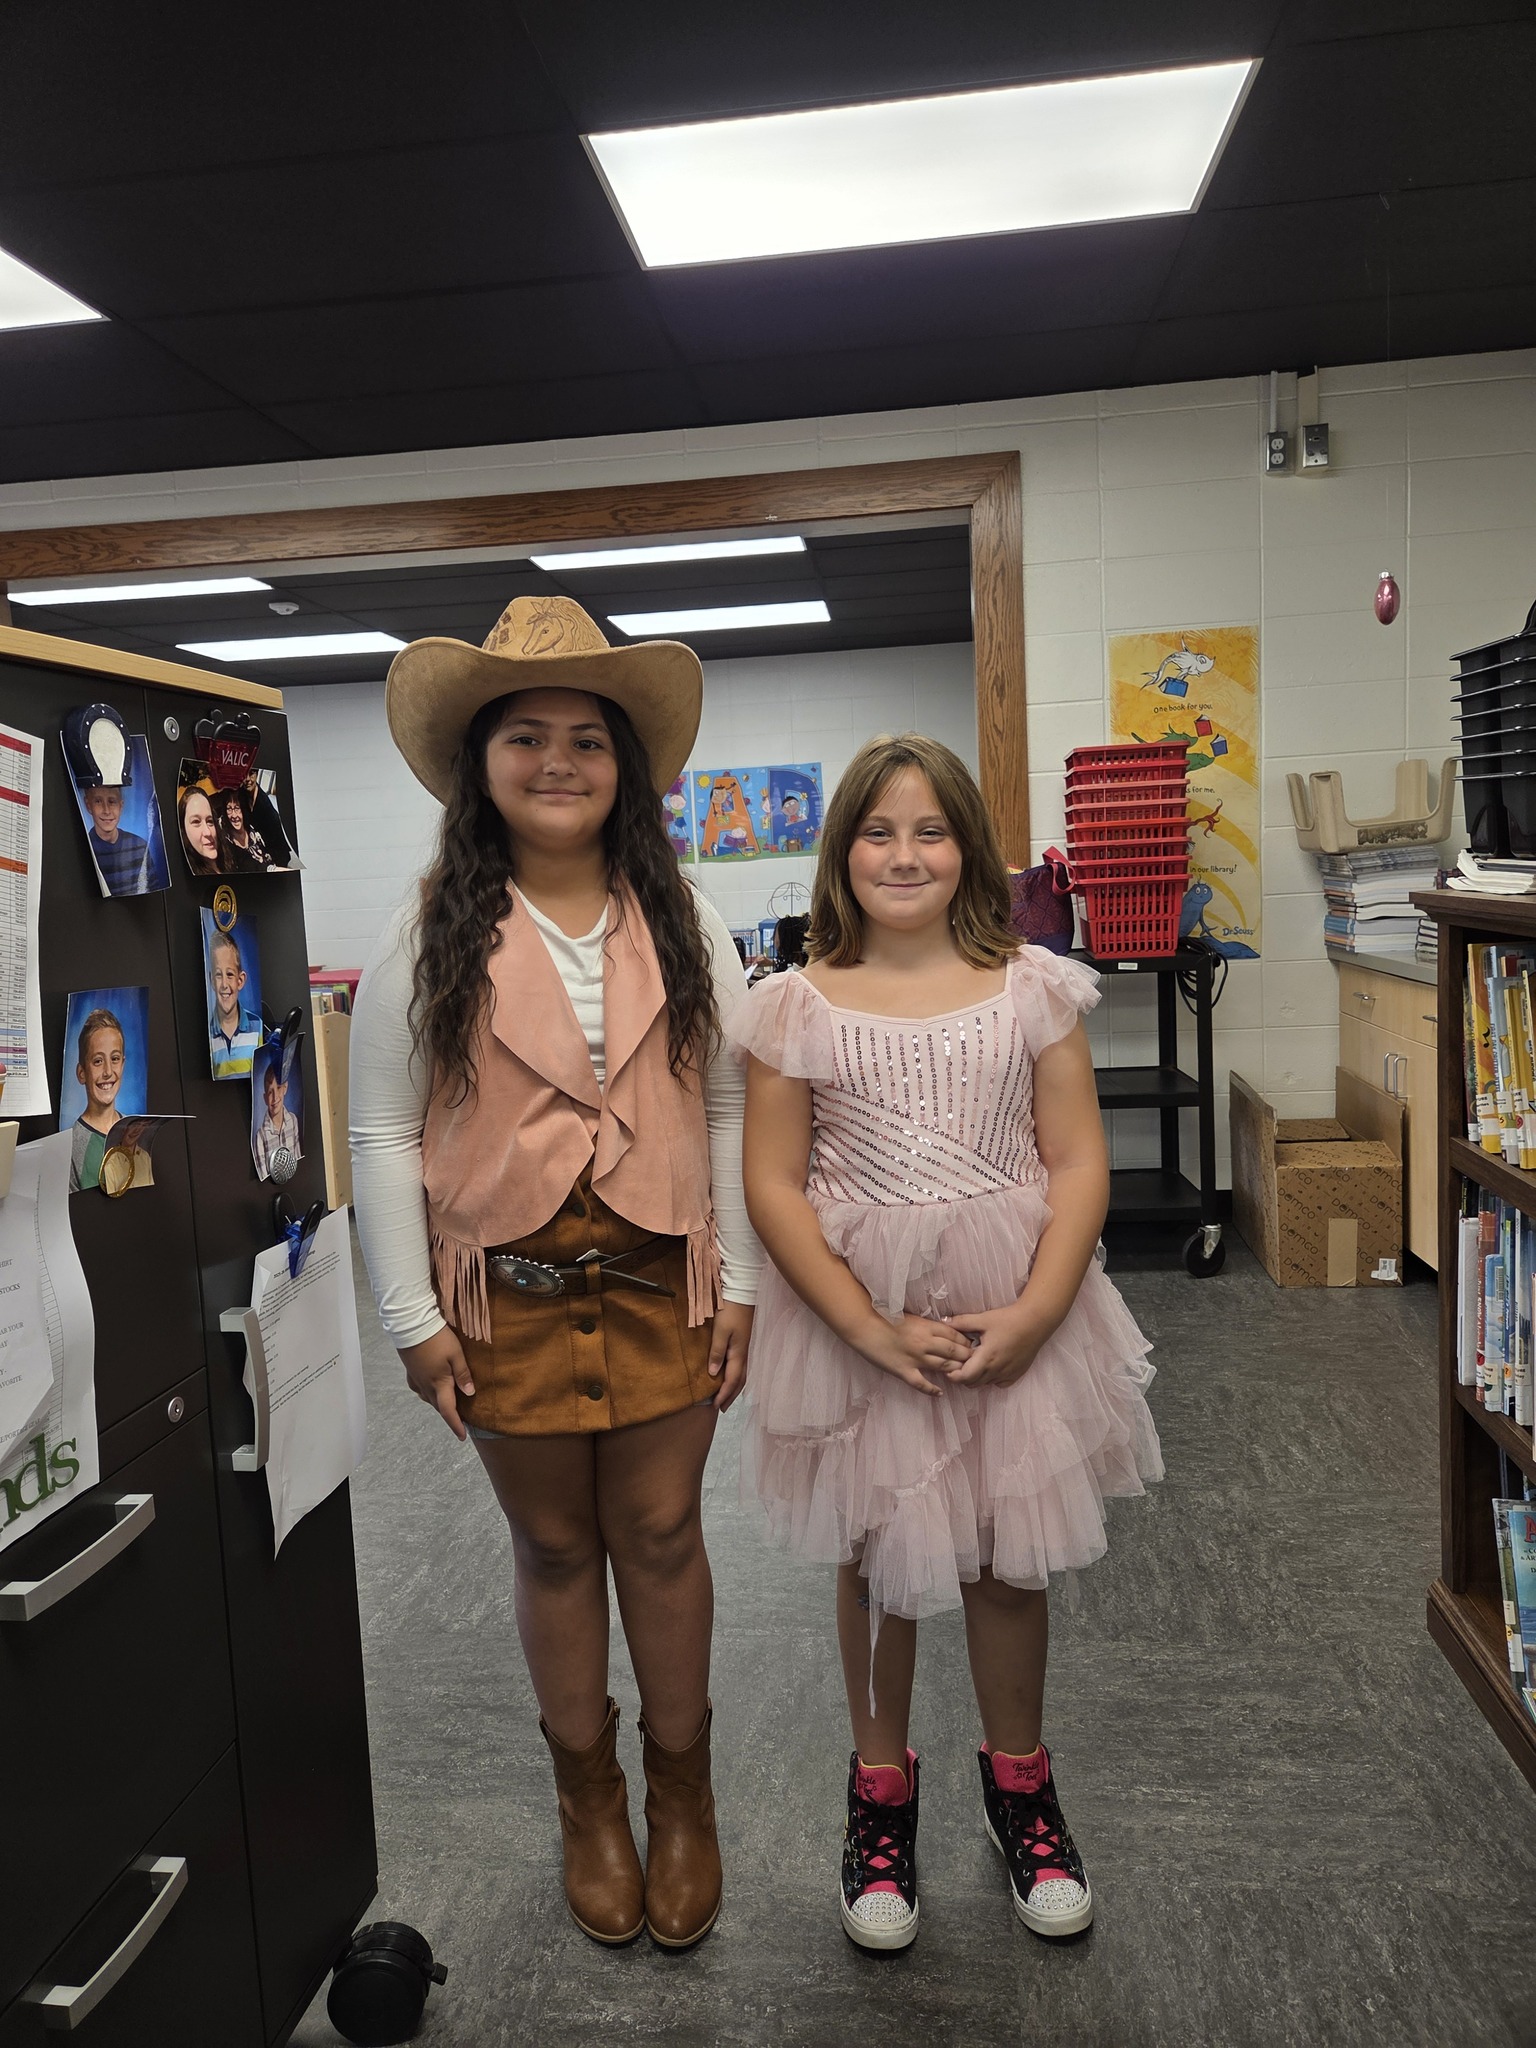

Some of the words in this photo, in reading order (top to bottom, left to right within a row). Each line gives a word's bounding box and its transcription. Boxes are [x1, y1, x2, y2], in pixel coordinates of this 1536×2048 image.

[221, 749, 249, 767] VALIC
[1210, 864, 1237, 874] library!
[1012, 1760, 1040, 1772] Twinkle
